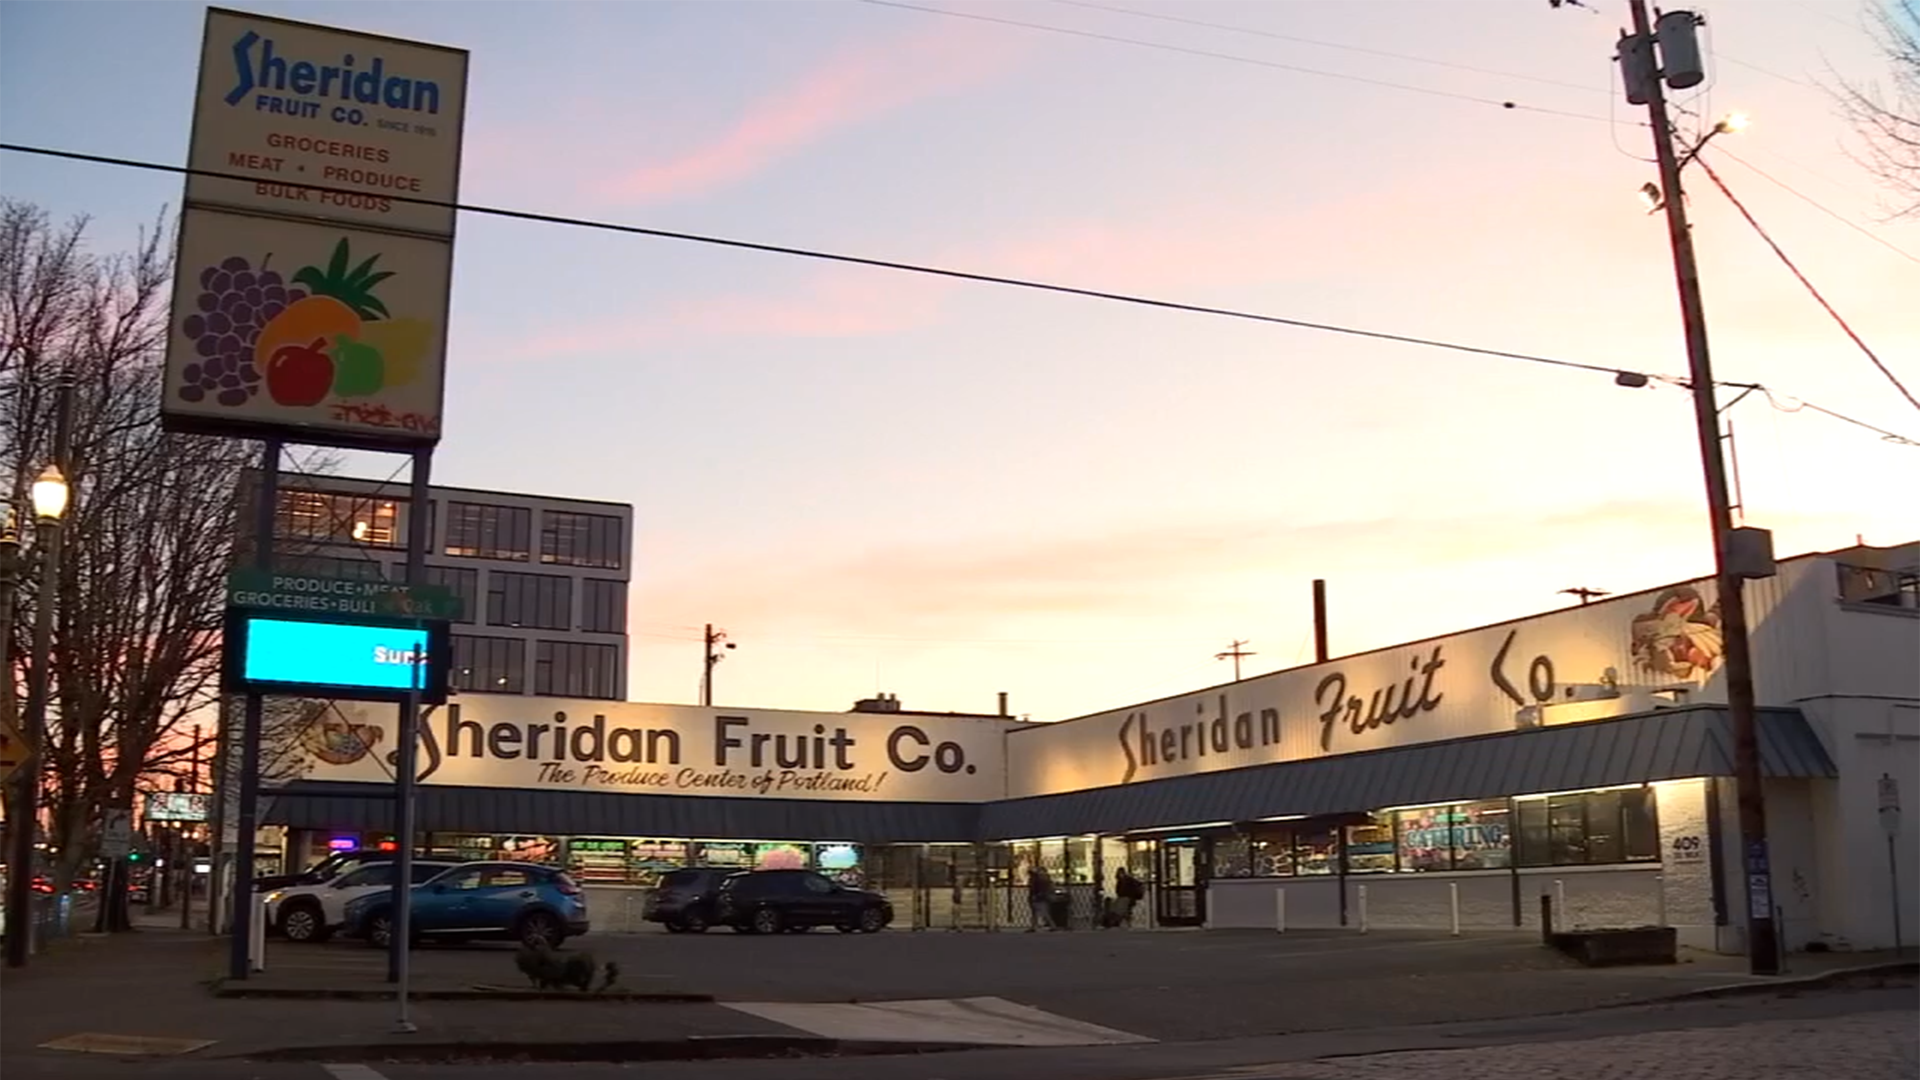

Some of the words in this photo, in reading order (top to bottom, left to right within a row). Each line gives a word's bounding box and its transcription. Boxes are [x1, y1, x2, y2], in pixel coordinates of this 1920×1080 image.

[223, 30, 440, 115] Sheridan
[255, 94, 320, 119] FRUIT
[331, 105, 369, 127] CO.
[267, 133, 391, 164] GROCERIES
[228, 152, 285, 173] MEAT
[323, 165, 422, 192] PRODUCE
[255, 180, 310, 203] BULK
[319, 189, 393, 213] FOODS
[233, 590, 330, 611] GROCERIES
[1119, 693, 1281, 784] Sheridan
[1315, 645, 1445, 752] Fruit
[1490, 629, 1575, 706] Co.
[388, 699, 680, 783] Sheridan
[715, 716, 855, 771] Fruit
[886, 725, 977, 775] Co.
[537, 762, 576, 783] The
[582, 764, 669, 787] Produce
[675, 767, 748, 789] Center
[751, 769, 774, 794] of
[776, 770, 888, 792] Portland!
[1672, 835, 1700, 851] 409
